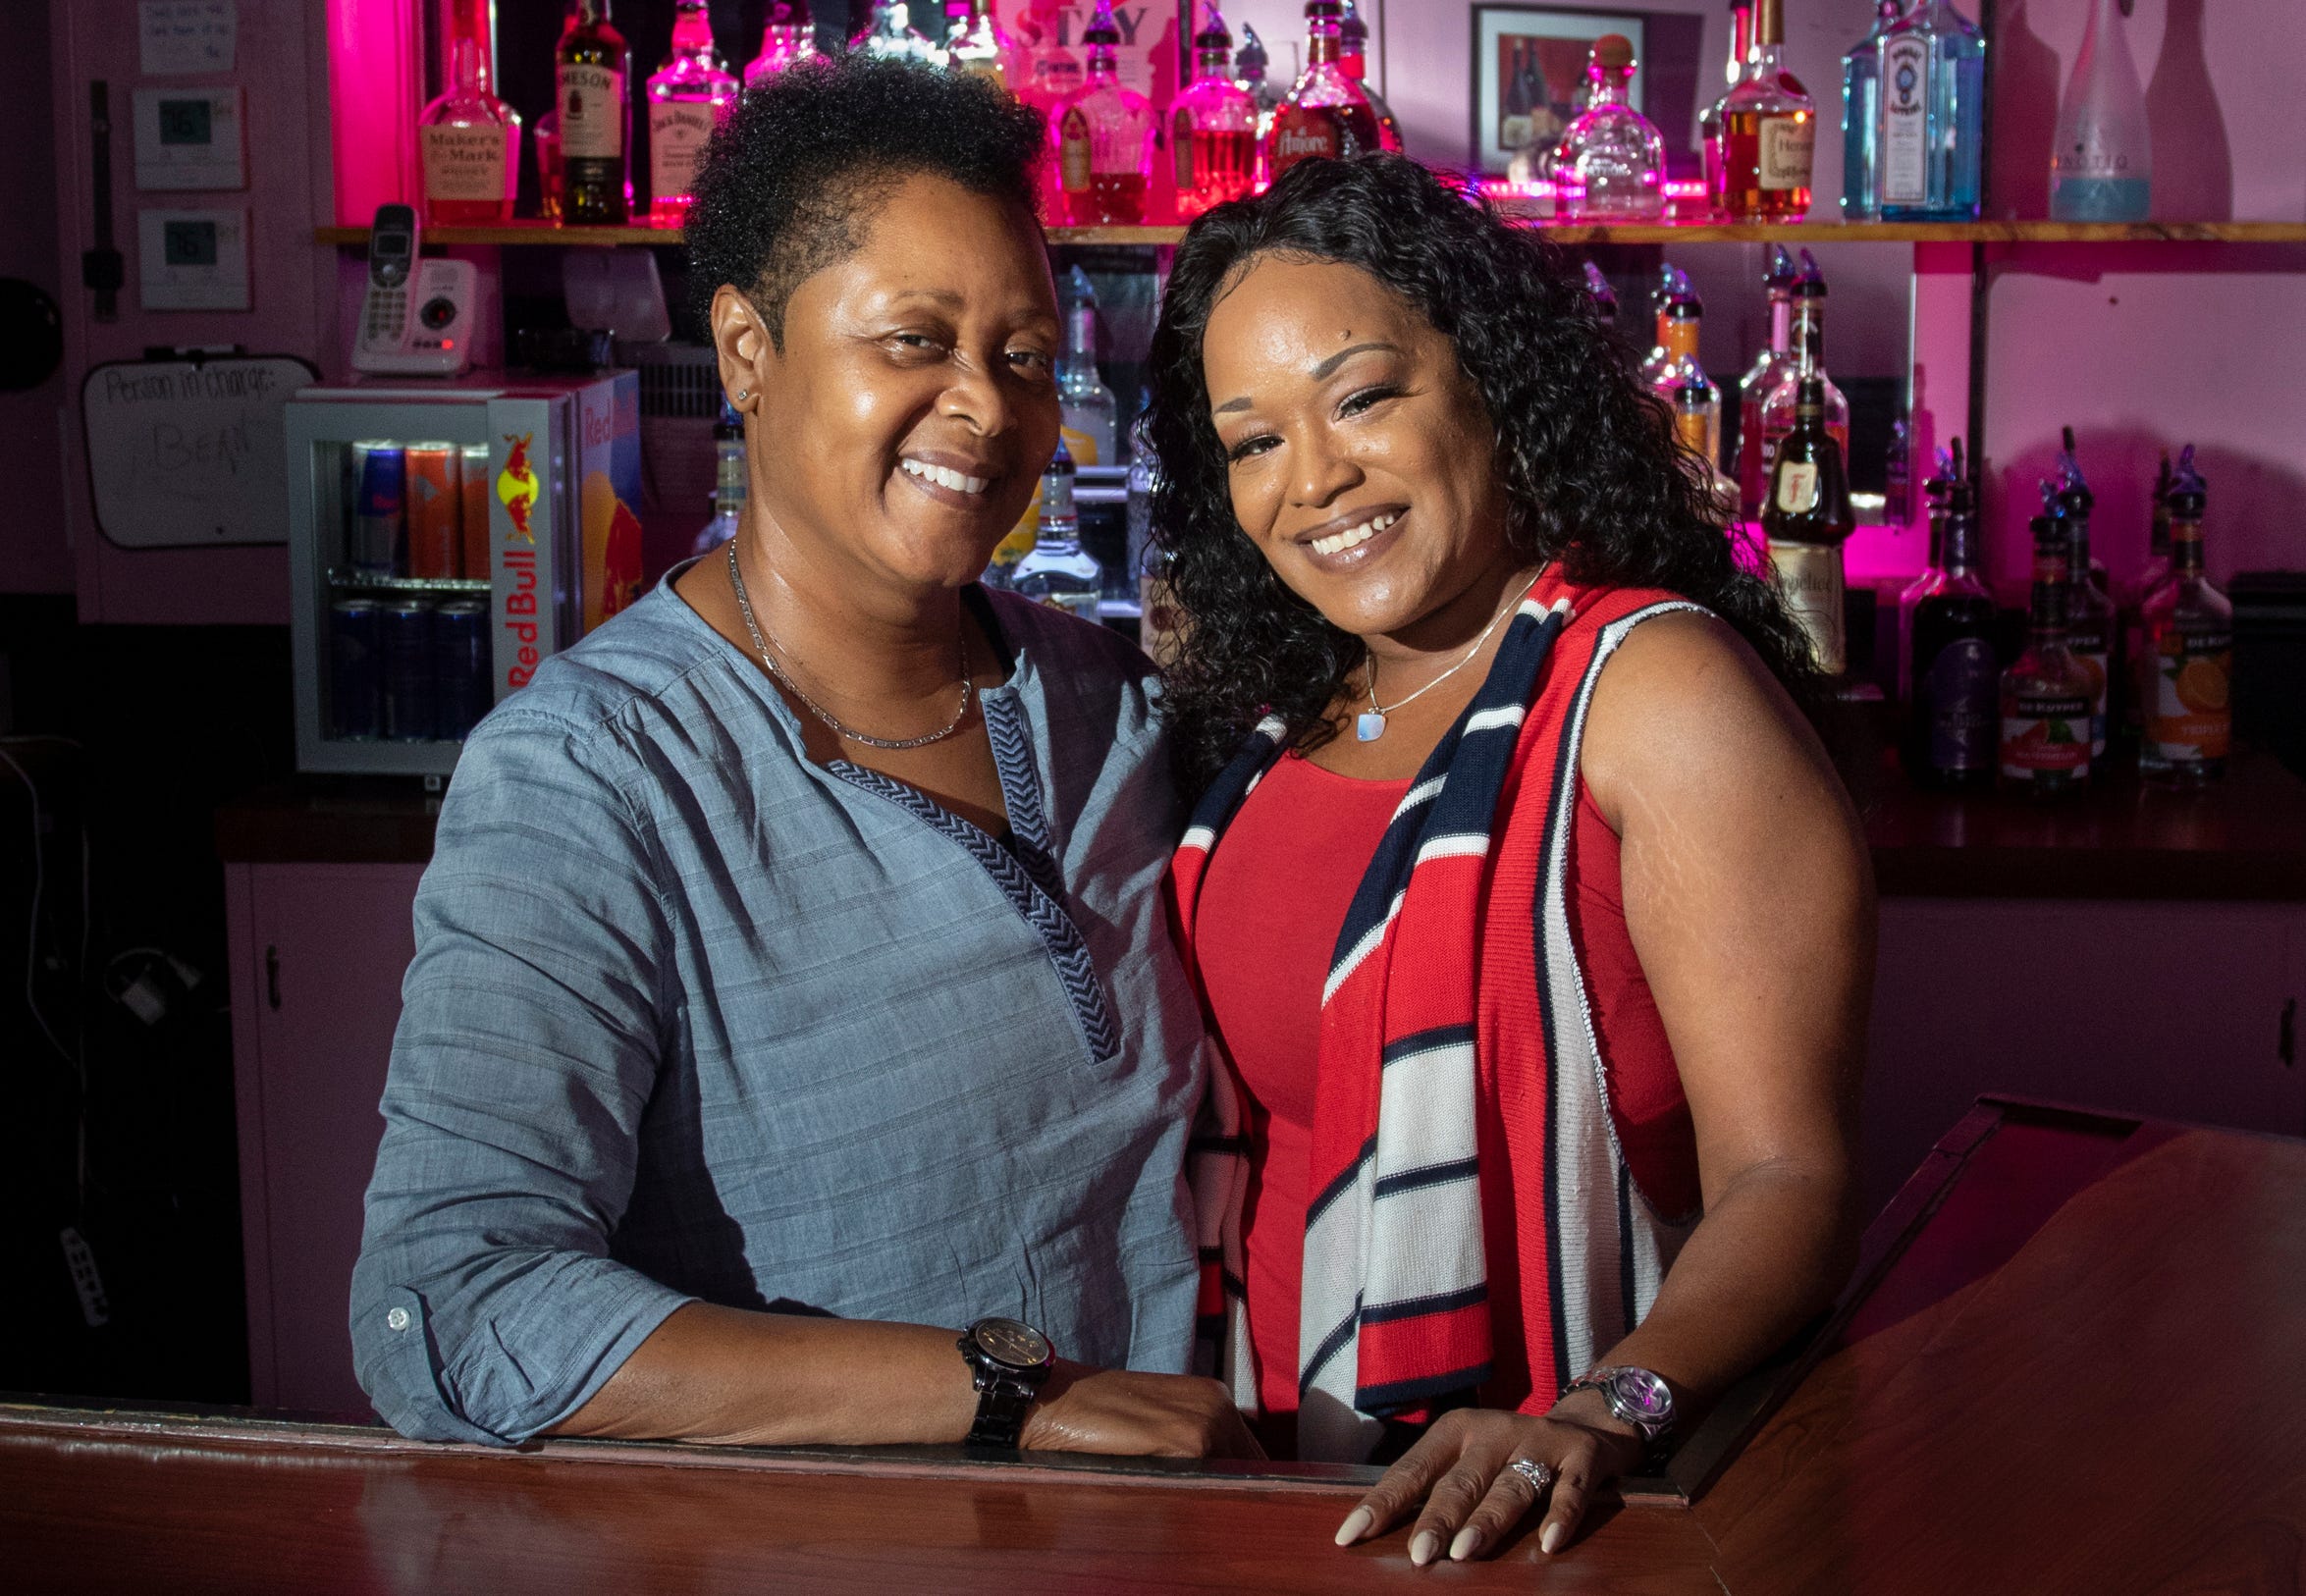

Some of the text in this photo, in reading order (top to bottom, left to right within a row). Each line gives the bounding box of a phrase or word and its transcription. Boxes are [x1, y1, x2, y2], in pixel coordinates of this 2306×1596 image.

[450, 148, 500, 162] Mark
[104, 370, 174, 403] Person
[177, 369, 200, 399] in
[584, 399, 611, 449] Red
[503, 551, 539, 688] Red Bull
